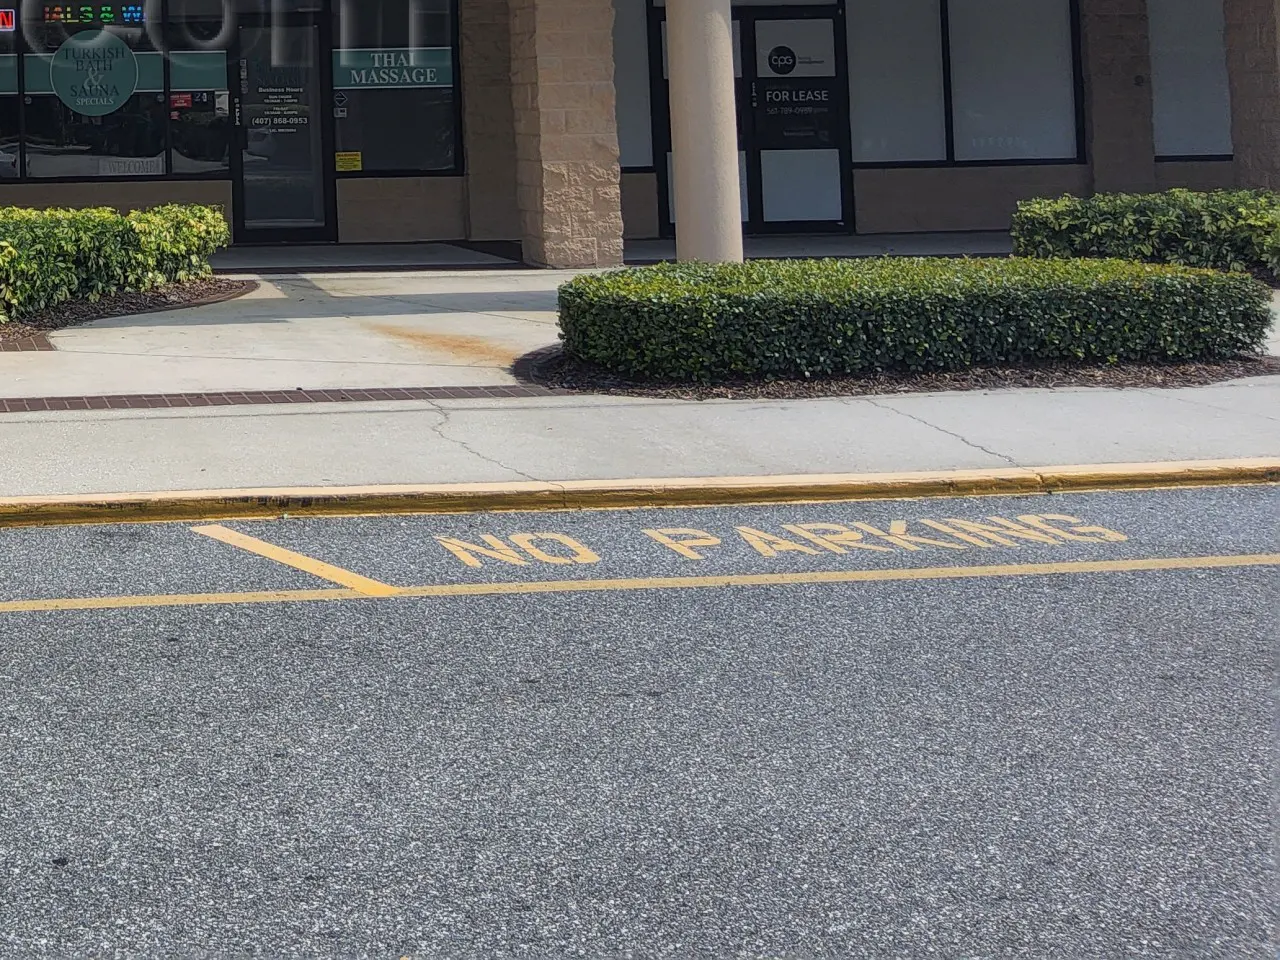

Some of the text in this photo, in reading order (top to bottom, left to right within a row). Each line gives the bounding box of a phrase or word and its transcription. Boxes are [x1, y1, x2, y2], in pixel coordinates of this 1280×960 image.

[64, 47, 125, 59] TURKISH
[371, 52, 416, 68] THAI
[75, 60, 113, 72] BATH
[83, 68, 104, 90] &
[350, 68, 437, 84] MASSAGE
[70, 84, 120, 98] SAUNA
[766, 90, 829, 102] FOR LEASE
[75, 97, 115, 106] SPECIALS
[251, 117, 272, 126] (407)
[107, 159, 155, 174] WELCOME
[434, 512, 1129, 568] NO PARKING
